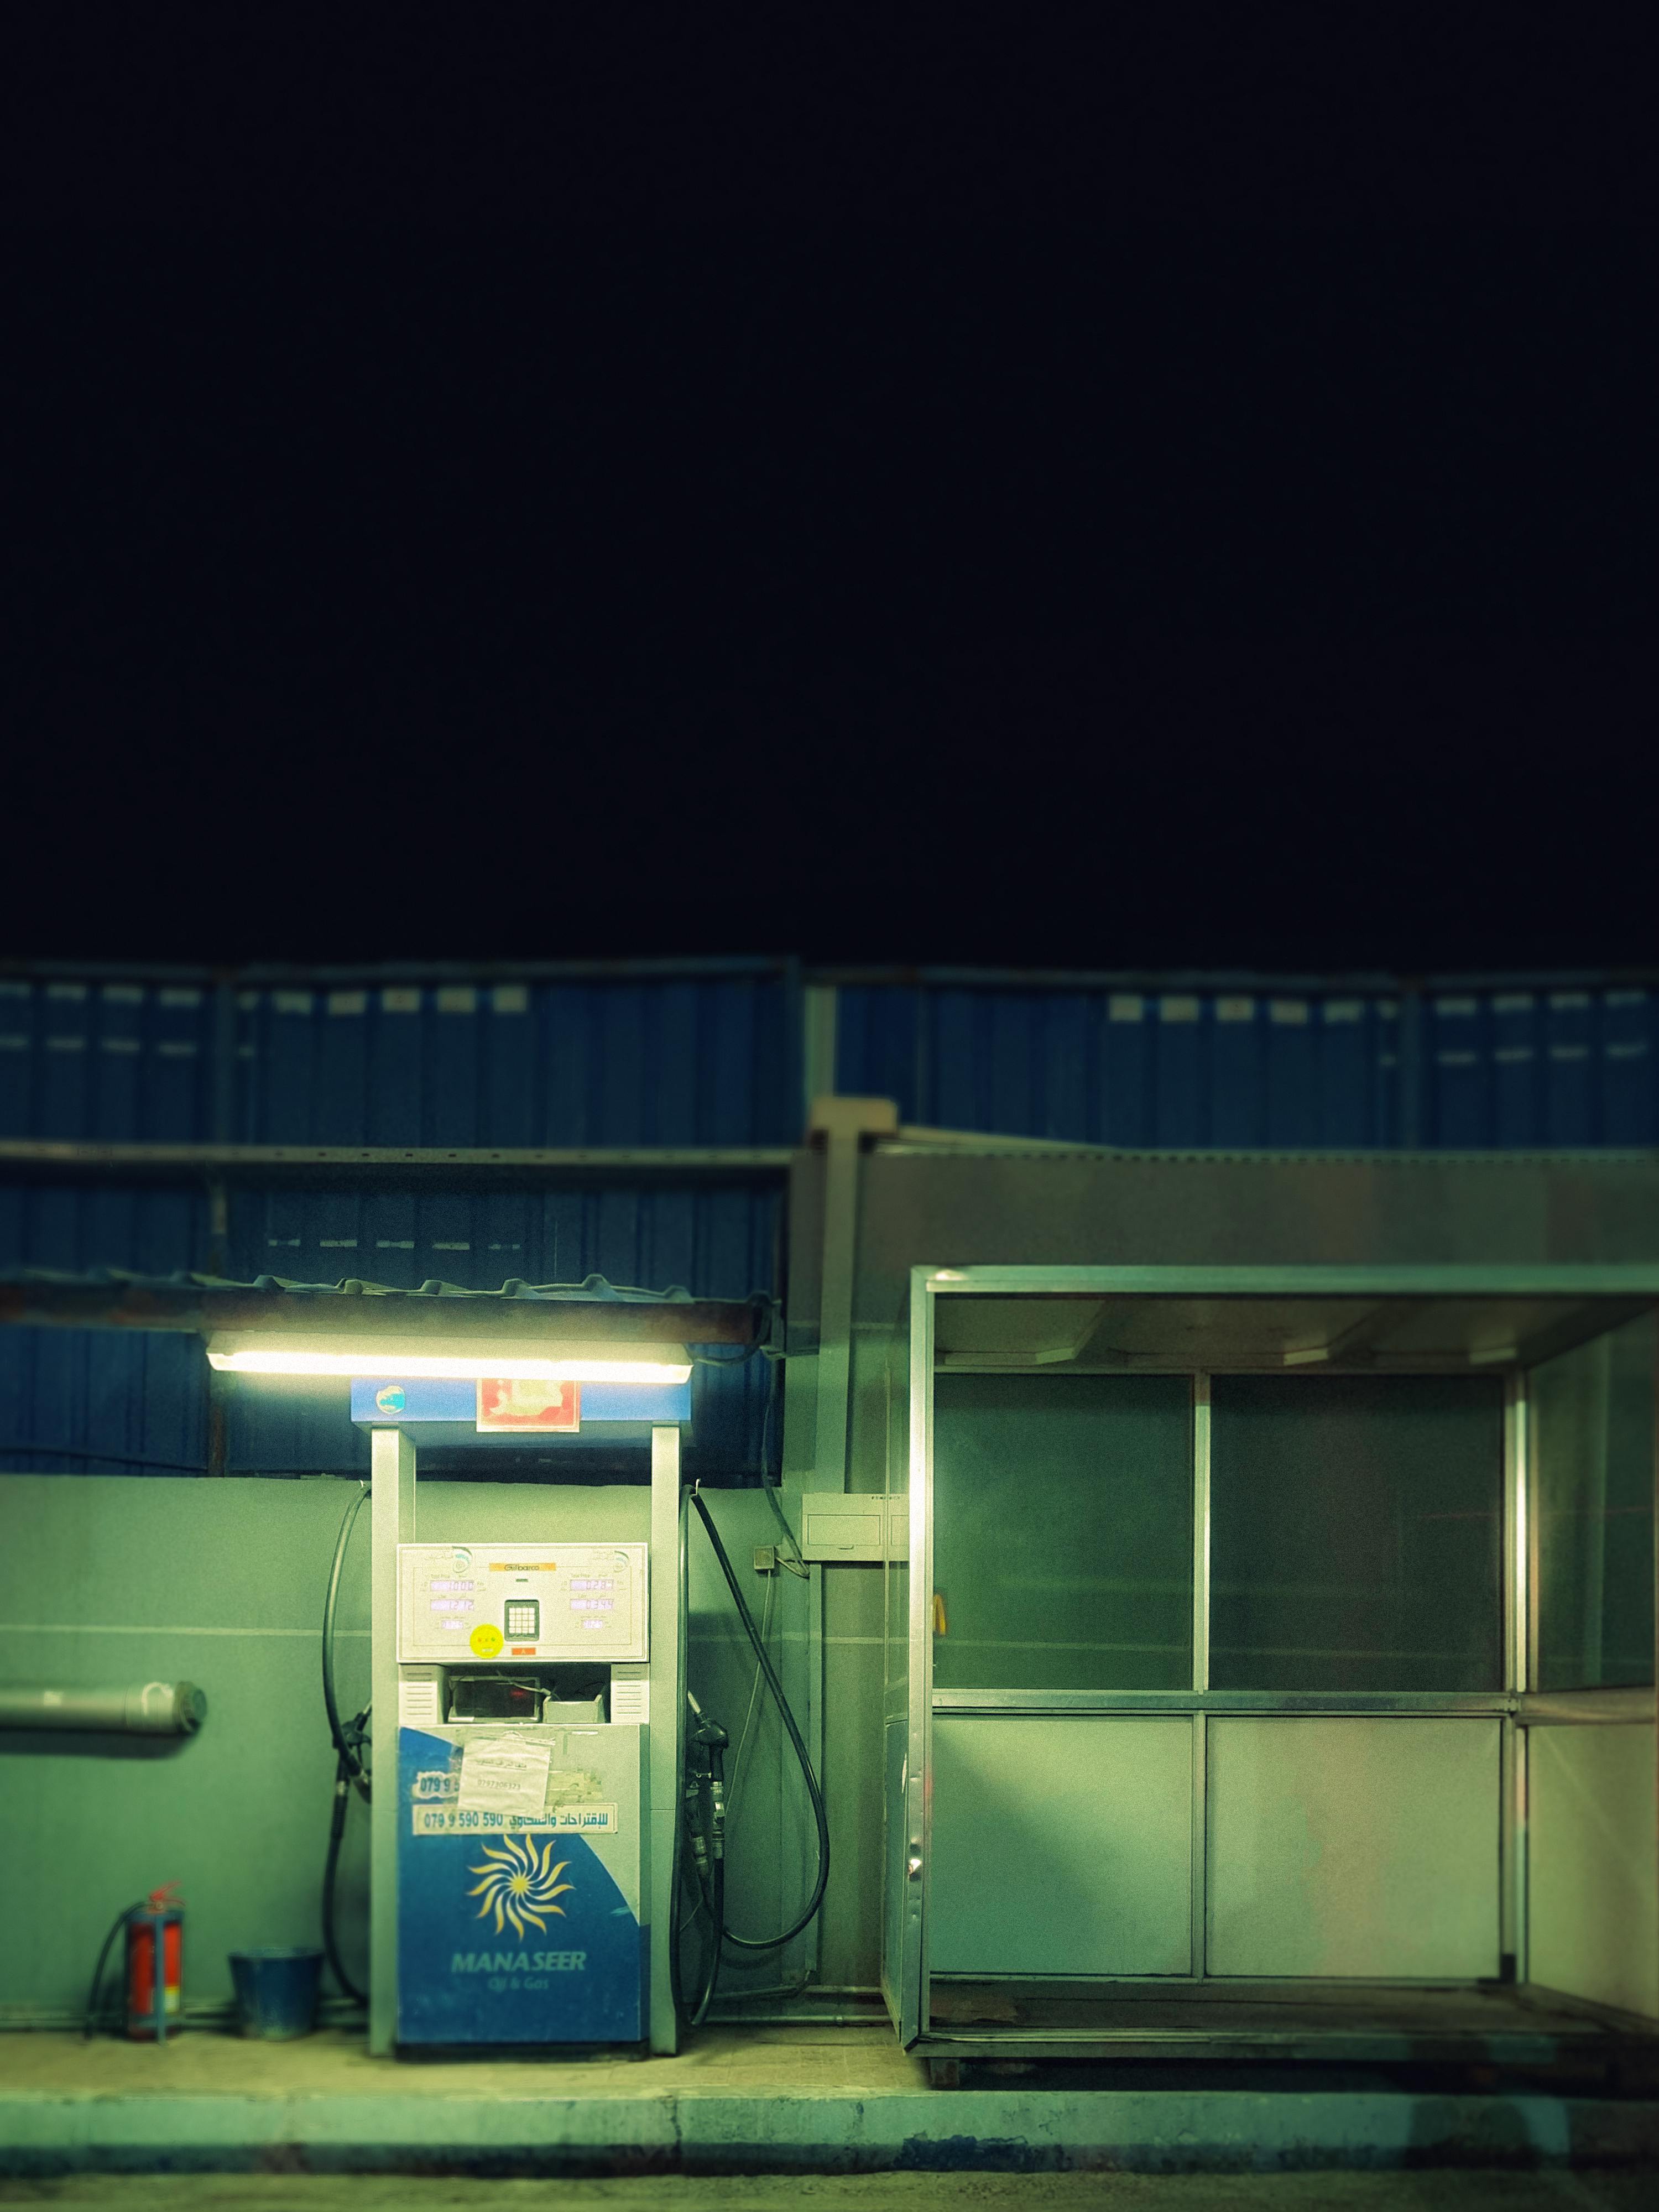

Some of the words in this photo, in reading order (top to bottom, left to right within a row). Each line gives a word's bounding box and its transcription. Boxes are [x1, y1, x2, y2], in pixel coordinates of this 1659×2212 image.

[420, 1777, 441, 1792] 079
[444, 1777, 451, 1792] 9
[424, 1813, 445, 1828] 079
[448, 1813, 455, 1828] 9
[459, 1811, 479, 1827] 590
[483, 1812, 503, 1827] 590
[451, 1951, 587, 1973] MANASEER
[488, 1977, 506, 1991] Oil
[510, 1977, 520, 1989] &
[524, 1977, 549, 1989] Gas
